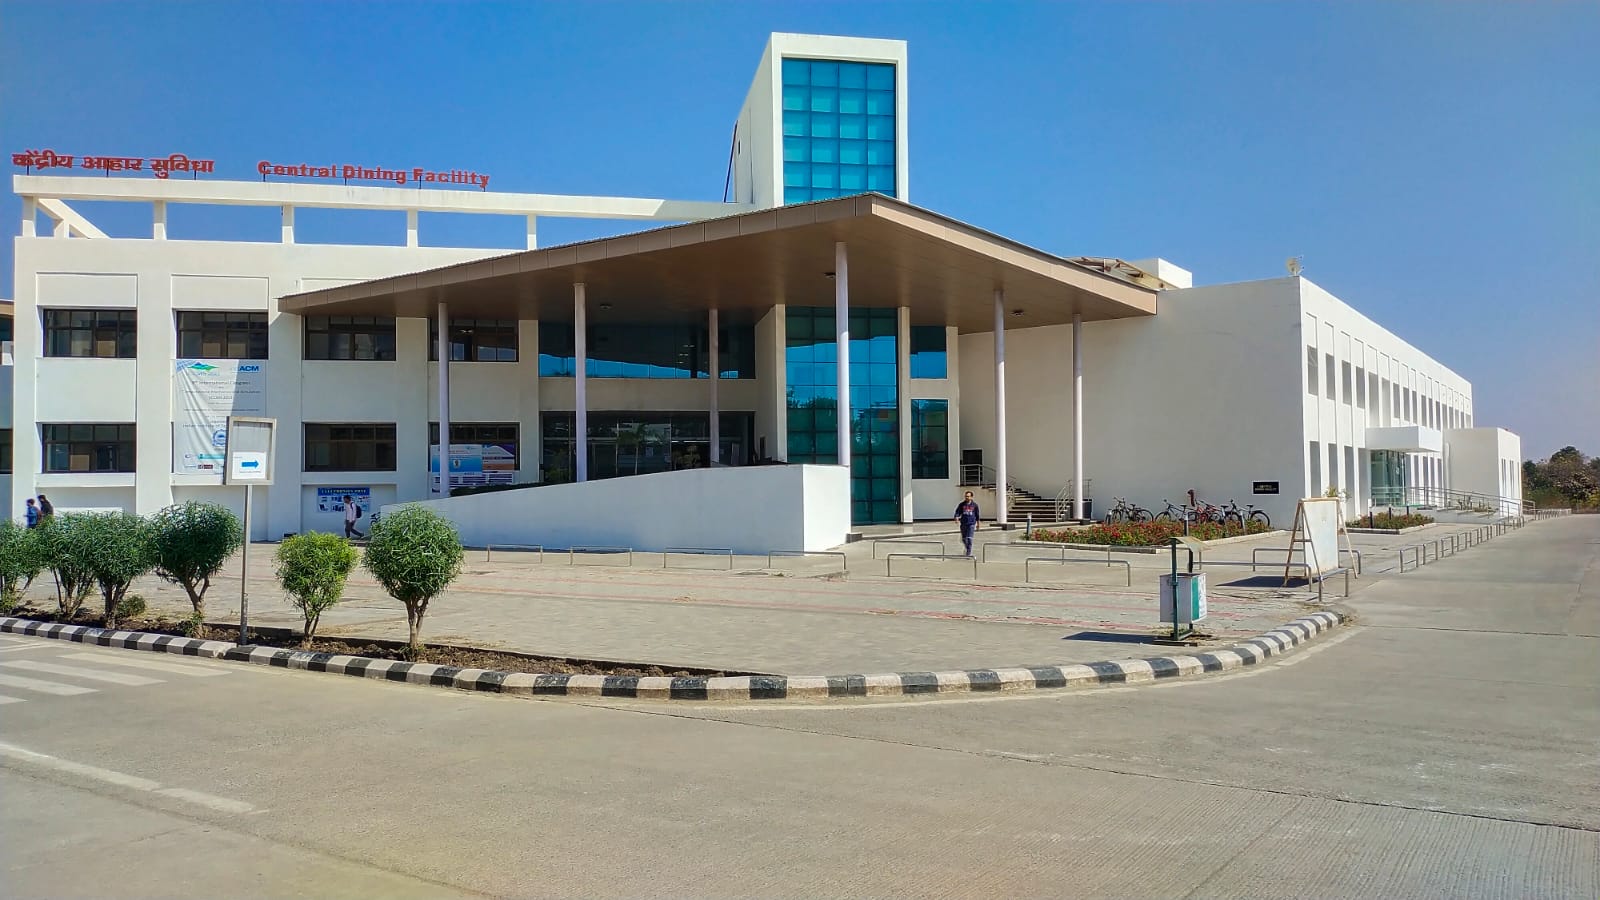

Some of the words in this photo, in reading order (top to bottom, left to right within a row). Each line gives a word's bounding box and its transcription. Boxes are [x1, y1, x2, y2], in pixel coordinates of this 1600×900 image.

[81, 156, 144, 171] आहार
[151, 154, 215, 179] सुविधा
[257, 161, 337, 178] Central
[342, 165, 407, 184] Dining
[412, 168, 490, 188] Facility
